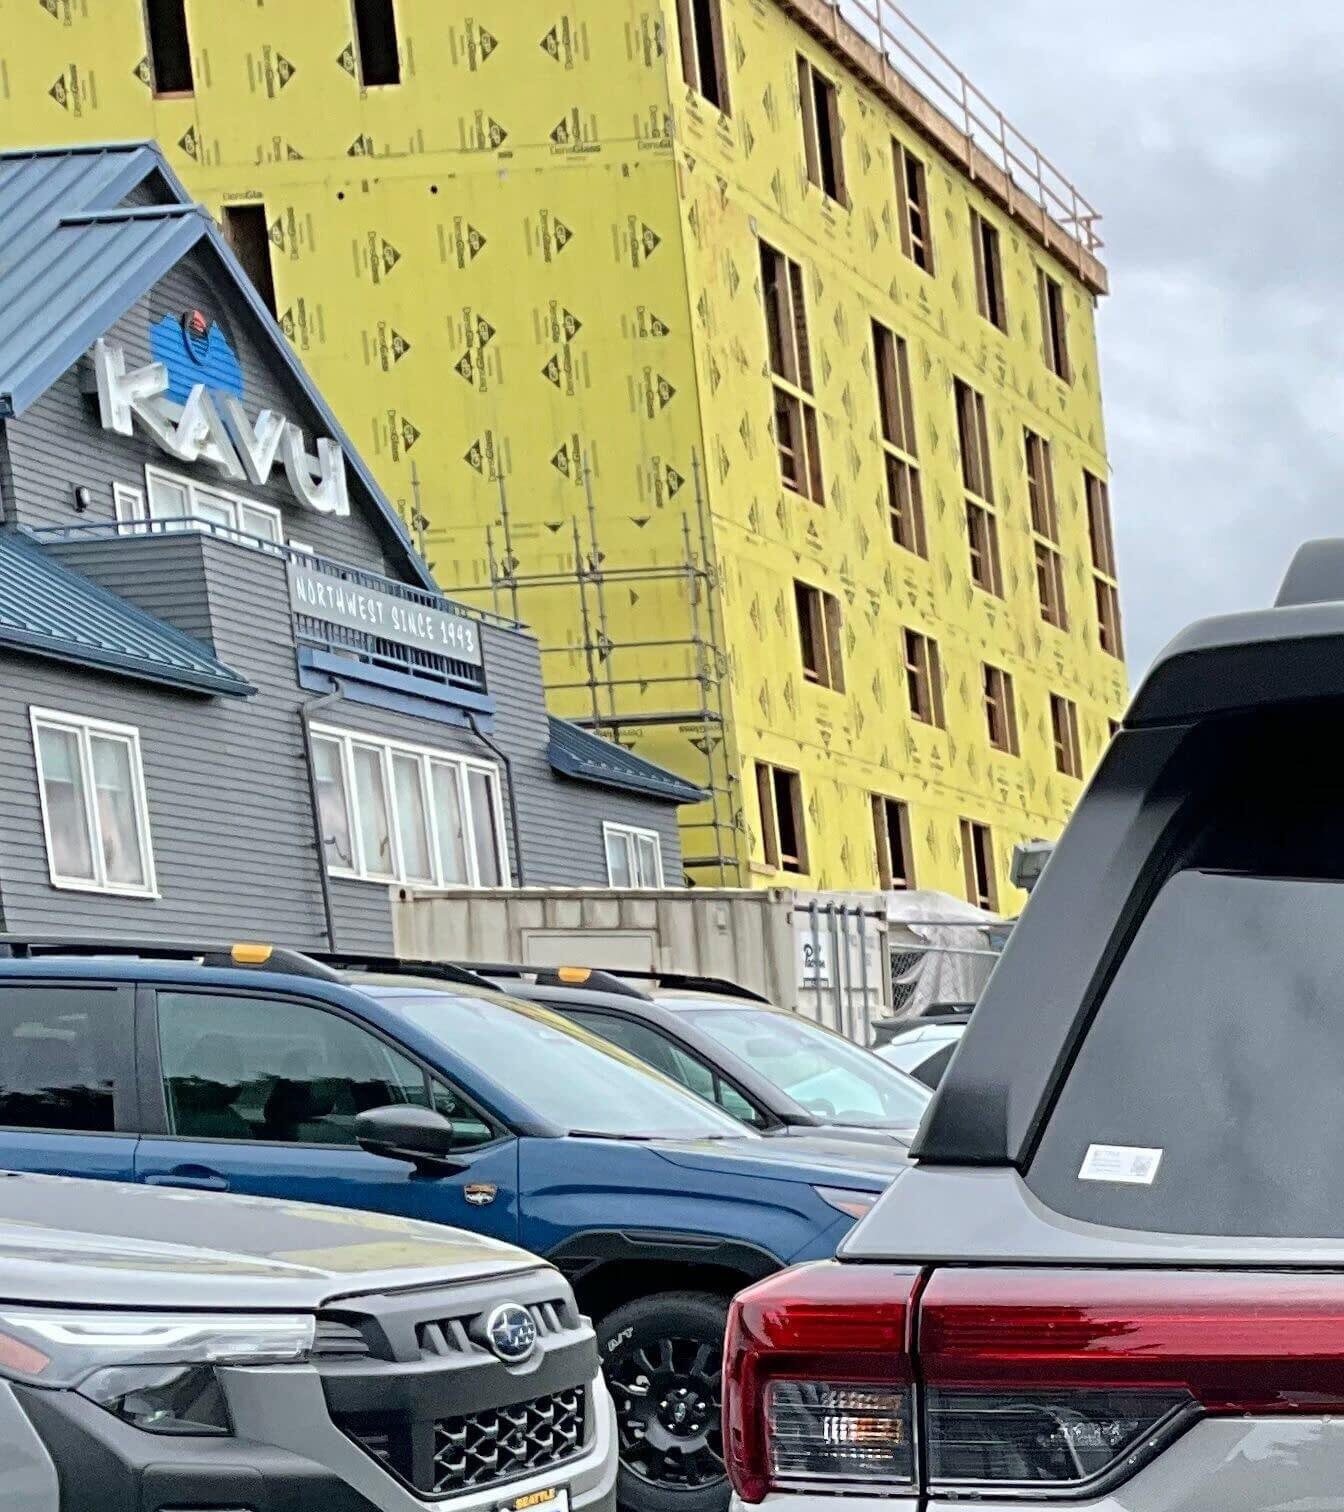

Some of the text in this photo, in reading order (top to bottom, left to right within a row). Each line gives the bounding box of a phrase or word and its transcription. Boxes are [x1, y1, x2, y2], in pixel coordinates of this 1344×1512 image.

[95, 338, 350, 516] KAVU
[296, 577, 474, 652] NORTHWEST SINCE 1993
